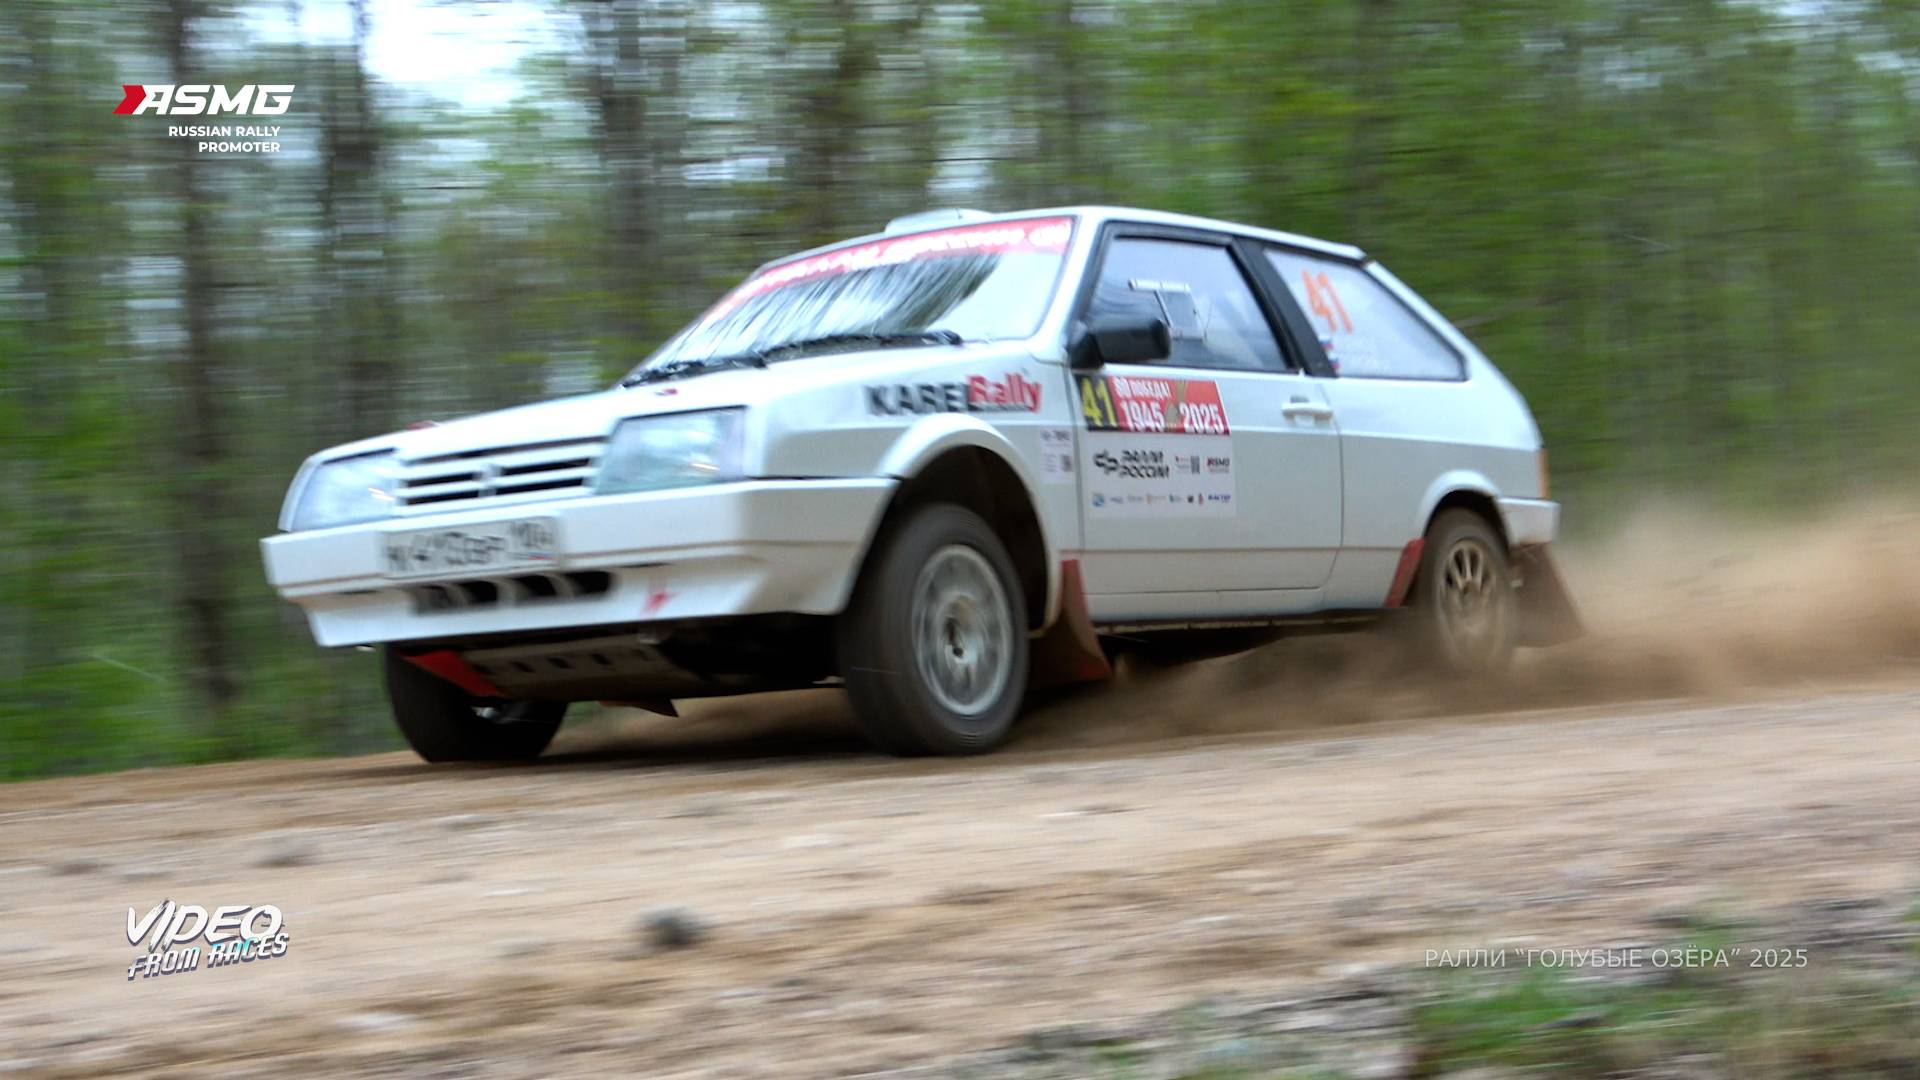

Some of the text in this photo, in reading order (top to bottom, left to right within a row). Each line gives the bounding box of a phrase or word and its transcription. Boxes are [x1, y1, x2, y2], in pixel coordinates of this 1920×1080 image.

[1302, 270, 1353, 332] 41
[1081, 377, 1118, 427] 41
[1121, 399, 1225, 434] 1945 2025
